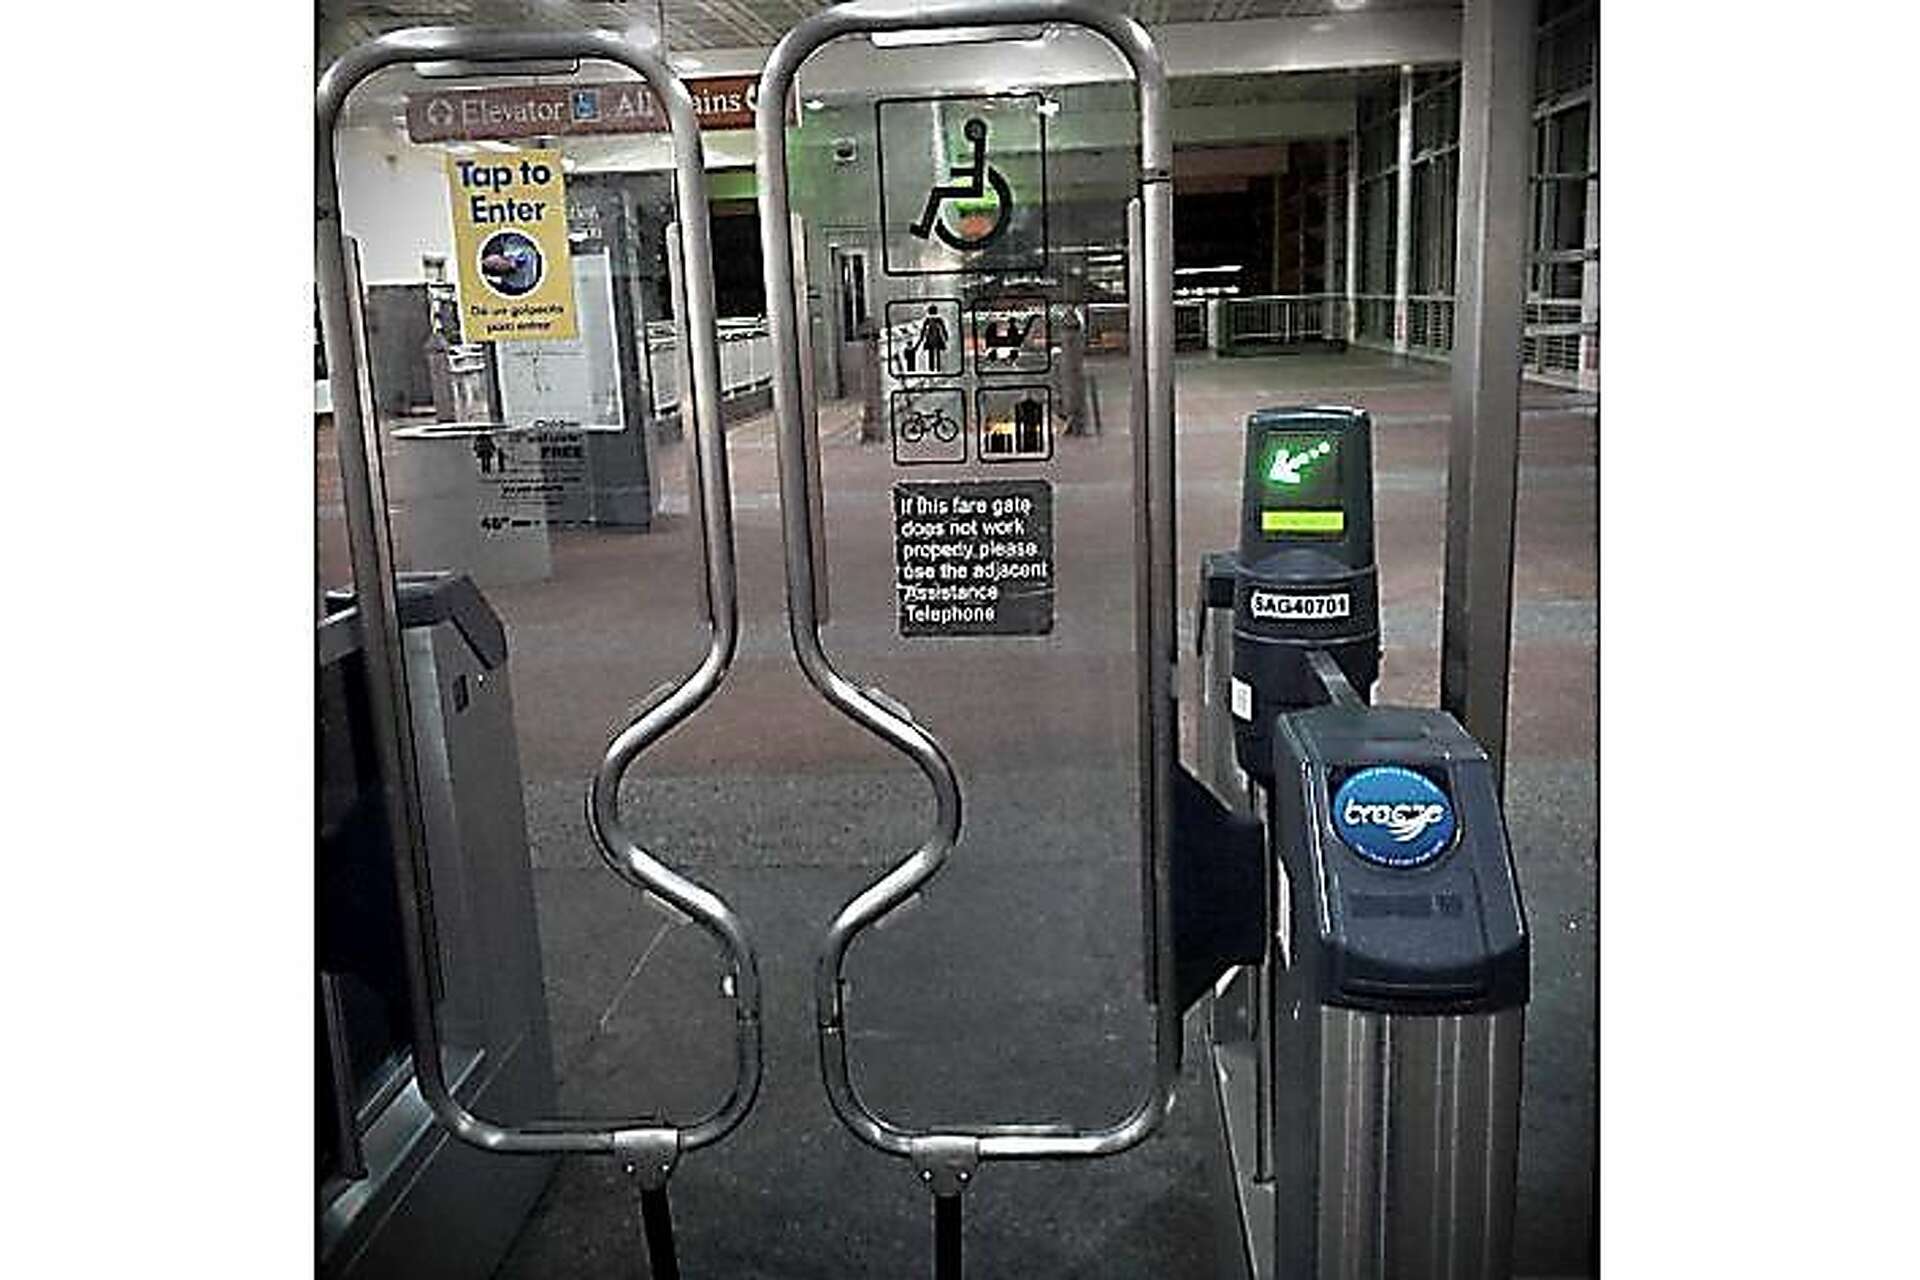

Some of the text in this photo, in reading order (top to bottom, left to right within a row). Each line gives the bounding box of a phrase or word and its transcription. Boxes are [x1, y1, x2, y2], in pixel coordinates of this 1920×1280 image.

[619, 88, 741, 116] All ains
[462, 99, 564, 126] Elevator
[457, 161, 551, 192] Tap to
[471, 195, 547, 223] Enter
[901, 496, 1032, 516] If this fare gate
[901, 518, 1025, 538] does not work
[979, 541, 1038, 560] please
[904, 560, 1048, 581] use the adjacent
[904, 584, 998, 601] Assistance
[906, 604, 995, 624] Telephone
